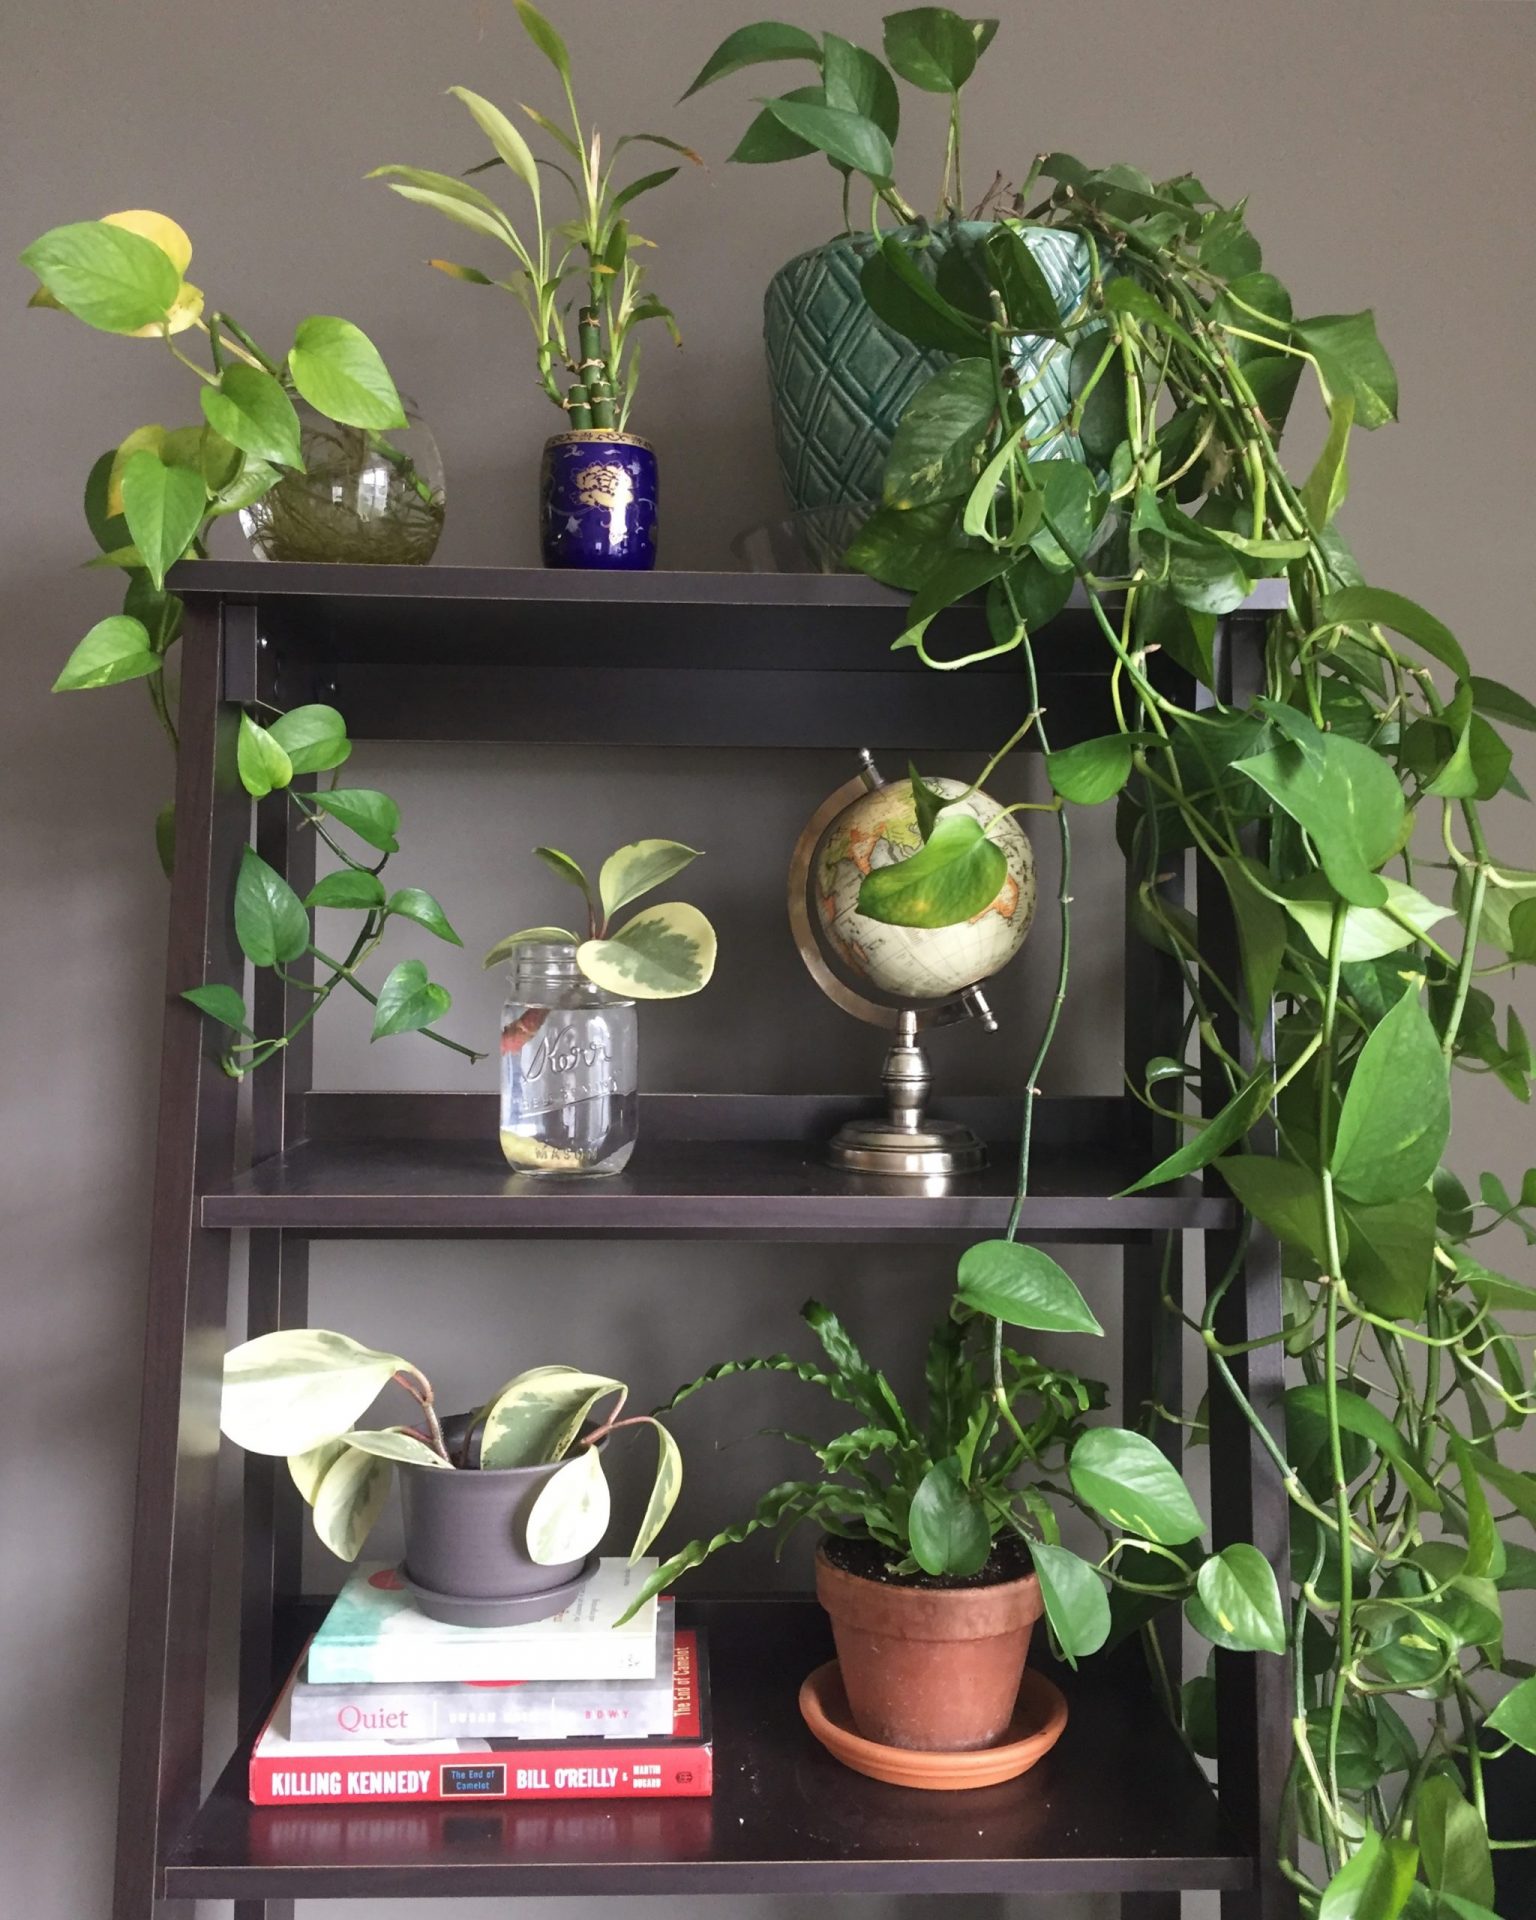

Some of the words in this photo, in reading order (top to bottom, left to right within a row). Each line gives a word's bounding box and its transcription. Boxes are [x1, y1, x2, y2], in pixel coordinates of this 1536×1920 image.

[535, 1147, 598, 1161] MASON
[672, 1646, 691, 1676] Camelot
[673, 1677, 691, 1685] of
[673, 1686, 691, 1701] End
[673, 1702, 692, 1717] The
[337, 1705, 409, 1733] Quiet
[451, 1770, 466, 1780] The
[468, 1769, 484, 1779] End
[486, 1769, 496, 1779] of
[516, 1768, 550, 1790] BILL
[554, 1766, 619, 1789] O'REILLY
[622, 1771, 629, 1781] &
[271, 1771, 342, 1796] KILLING
[347, 1769, 431, 1795] KENNEDY
[456, 1781, 490, 1791] Camelot
